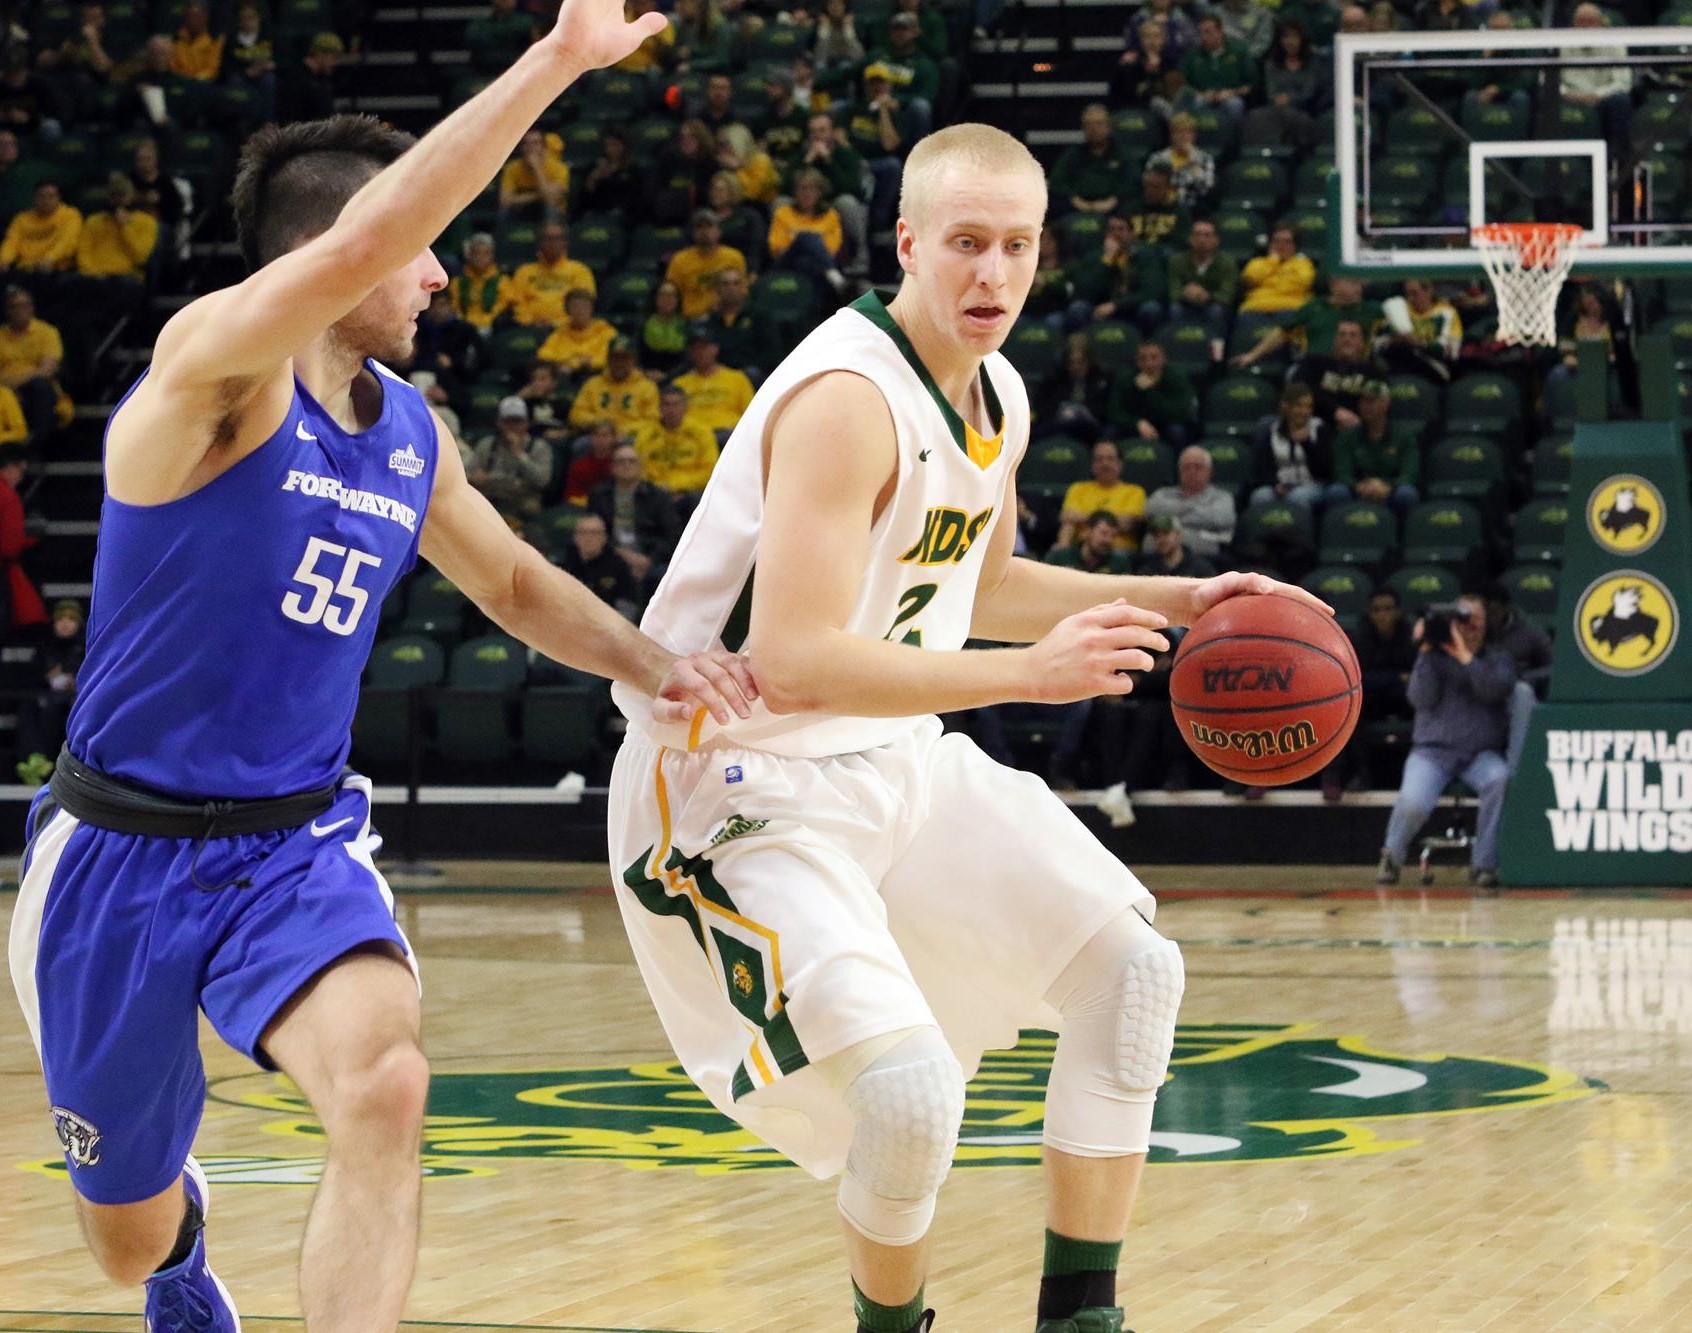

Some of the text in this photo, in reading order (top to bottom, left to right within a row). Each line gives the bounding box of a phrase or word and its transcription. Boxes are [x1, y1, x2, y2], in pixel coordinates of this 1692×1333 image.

[339, 486, 417, 533] WAYNE
[896, 505, 994, 567] NDS
[281, 536, 382, 636] 55
[1203, 663, 1294, 693] NCAA
[1190, 719, 1319, 758] Wilson
[1545, 729, 1692, 762] BUFFALO
[1545, 760, 1692, 810] WILD
[1545, 808, 1692, 852] WINGS
